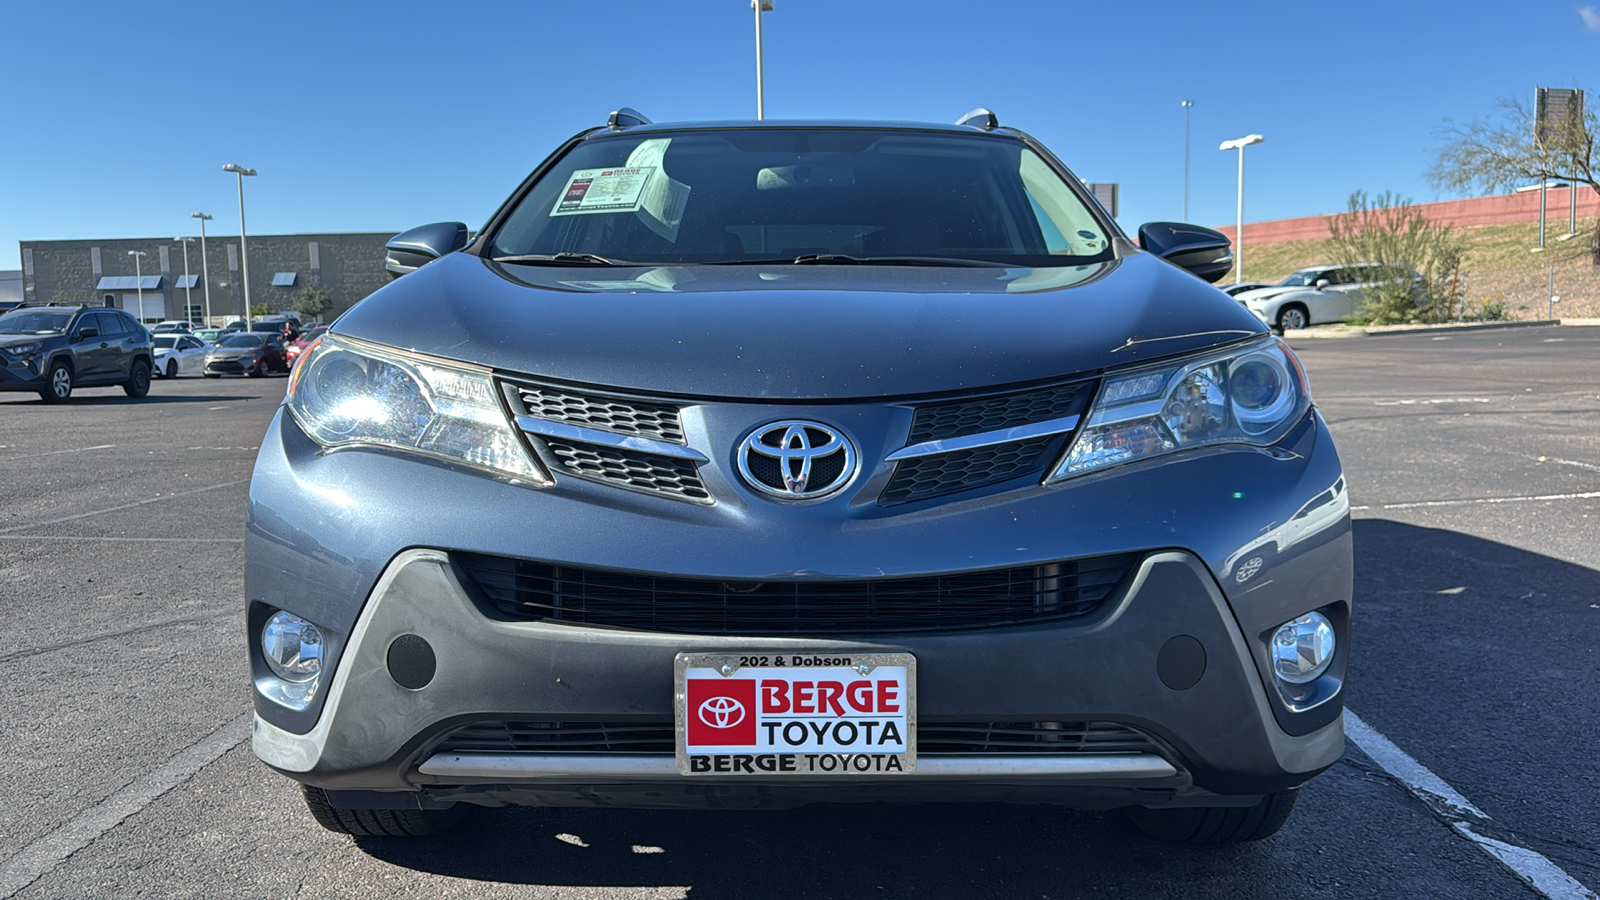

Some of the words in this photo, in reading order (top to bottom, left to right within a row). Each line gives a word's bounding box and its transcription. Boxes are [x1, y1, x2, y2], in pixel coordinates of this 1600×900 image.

[739, 656, 772, 667] 202
[774, 656, 786, 667] &
[792, 656, 852, 667] Dobson
[760, 679, 900, 718] BERGE
[761, 721, 903, 746] TOYOTA
[689, 754, 797, 773] BERGE
[804, 754, 903, 772] TOYOTA
